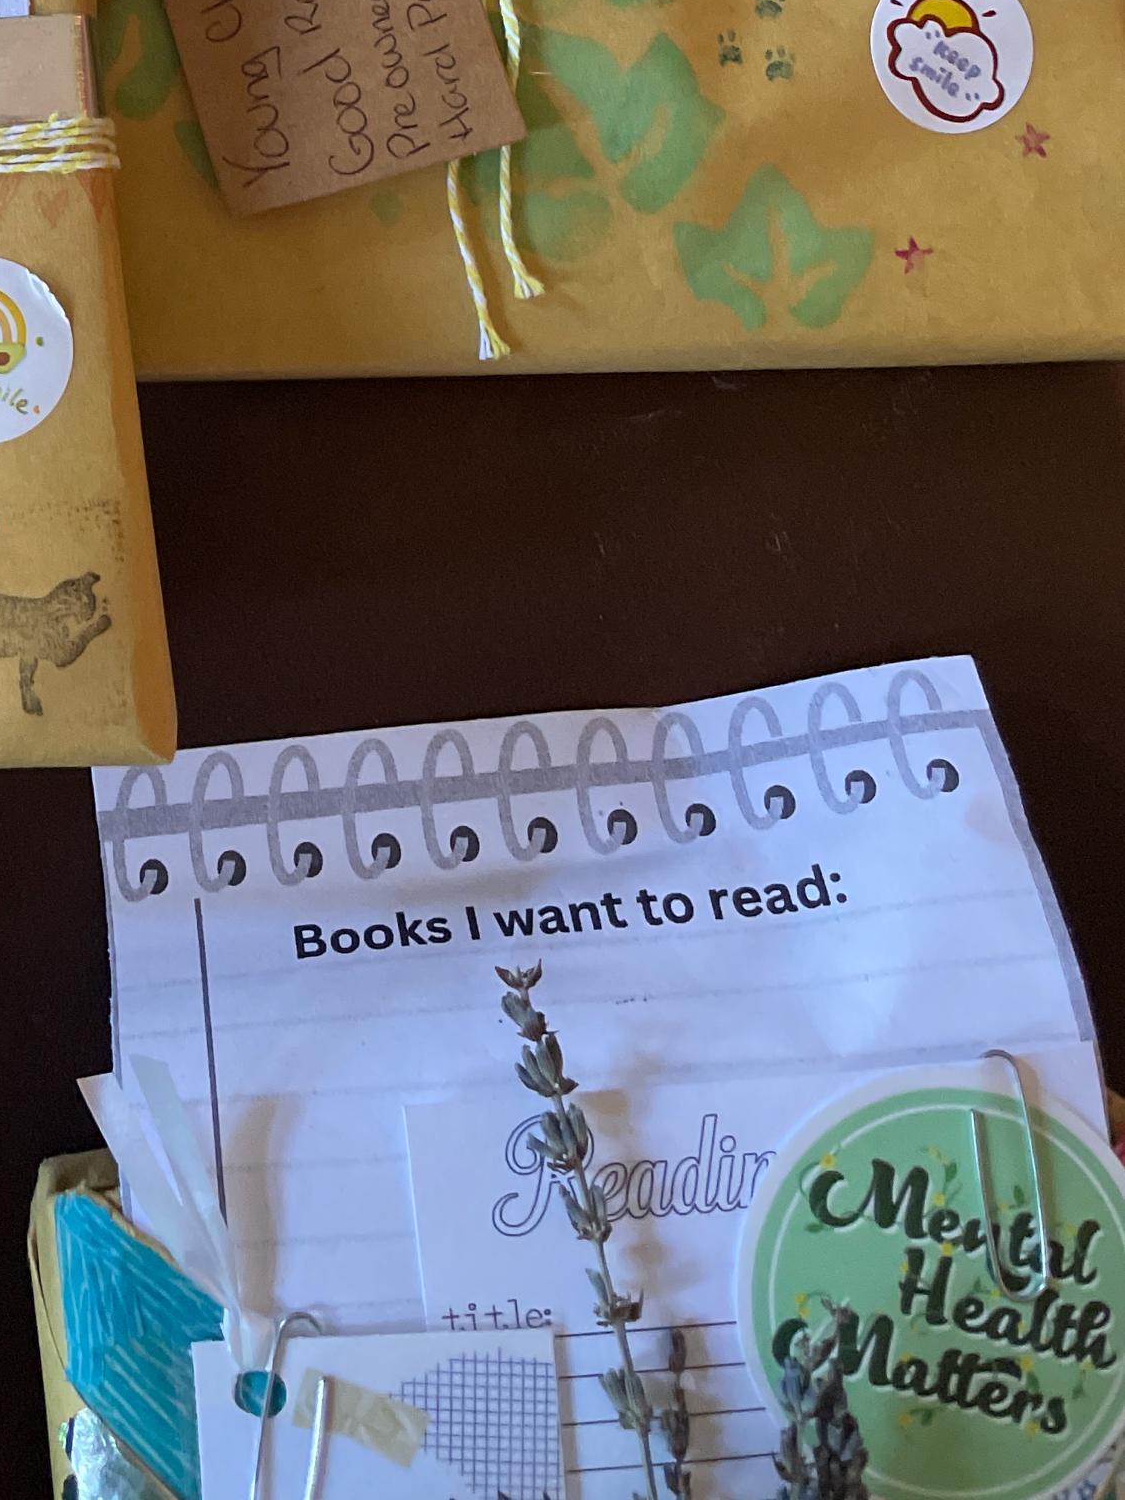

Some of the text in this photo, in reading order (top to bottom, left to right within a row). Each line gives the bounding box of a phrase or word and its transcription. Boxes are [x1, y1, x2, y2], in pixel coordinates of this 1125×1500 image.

[223, 46, 289, 189] Young
[302, 48, 375, 176] Good
[422, 43, 471, 141] Hard
[292, 863, 849, 960] Books I want to read:
[492, 1113, 776, 1237] Readin
[809, 1158, 1100, 1285] Mental
[442, 1299, 553, 1331] title:
[772, 1303, 1069, 1435] Matters
[898, 1247, 1117, 1369] Health
